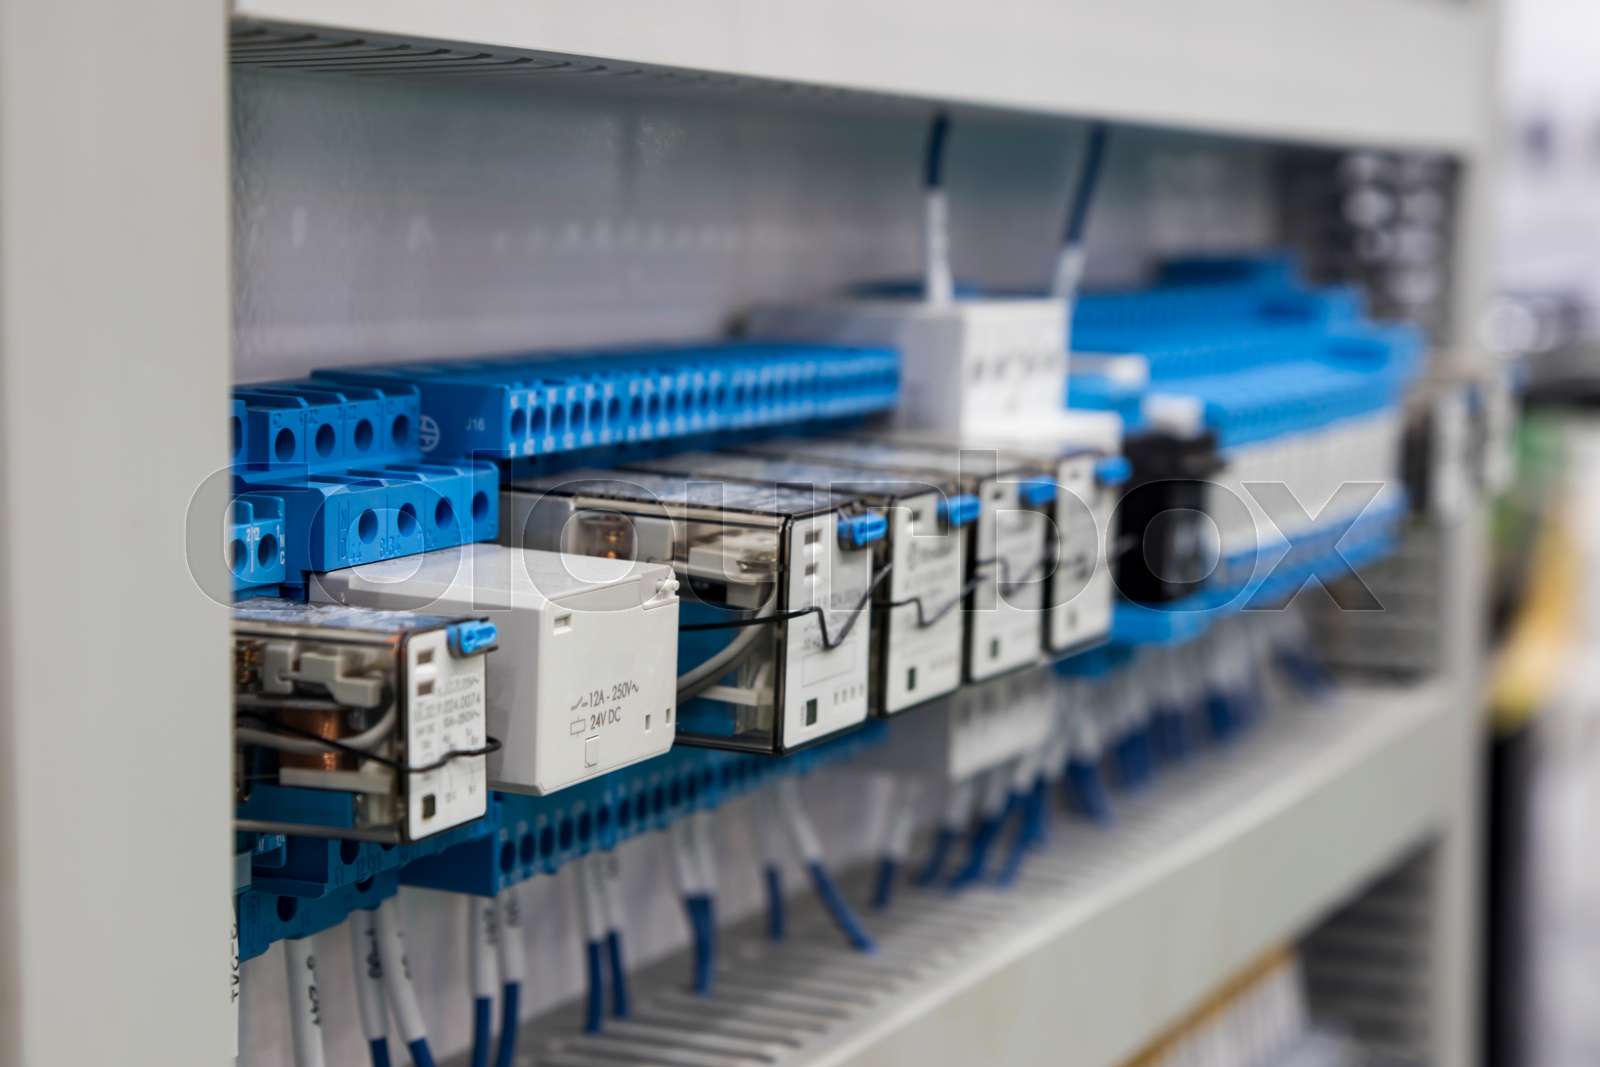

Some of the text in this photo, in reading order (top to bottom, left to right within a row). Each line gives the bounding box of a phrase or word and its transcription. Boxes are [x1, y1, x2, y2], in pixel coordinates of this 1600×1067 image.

[464, 416, 486, 432] J16
[589, 689, 605, 708] 12A
[590, 705, 621, 730] 24V DC
